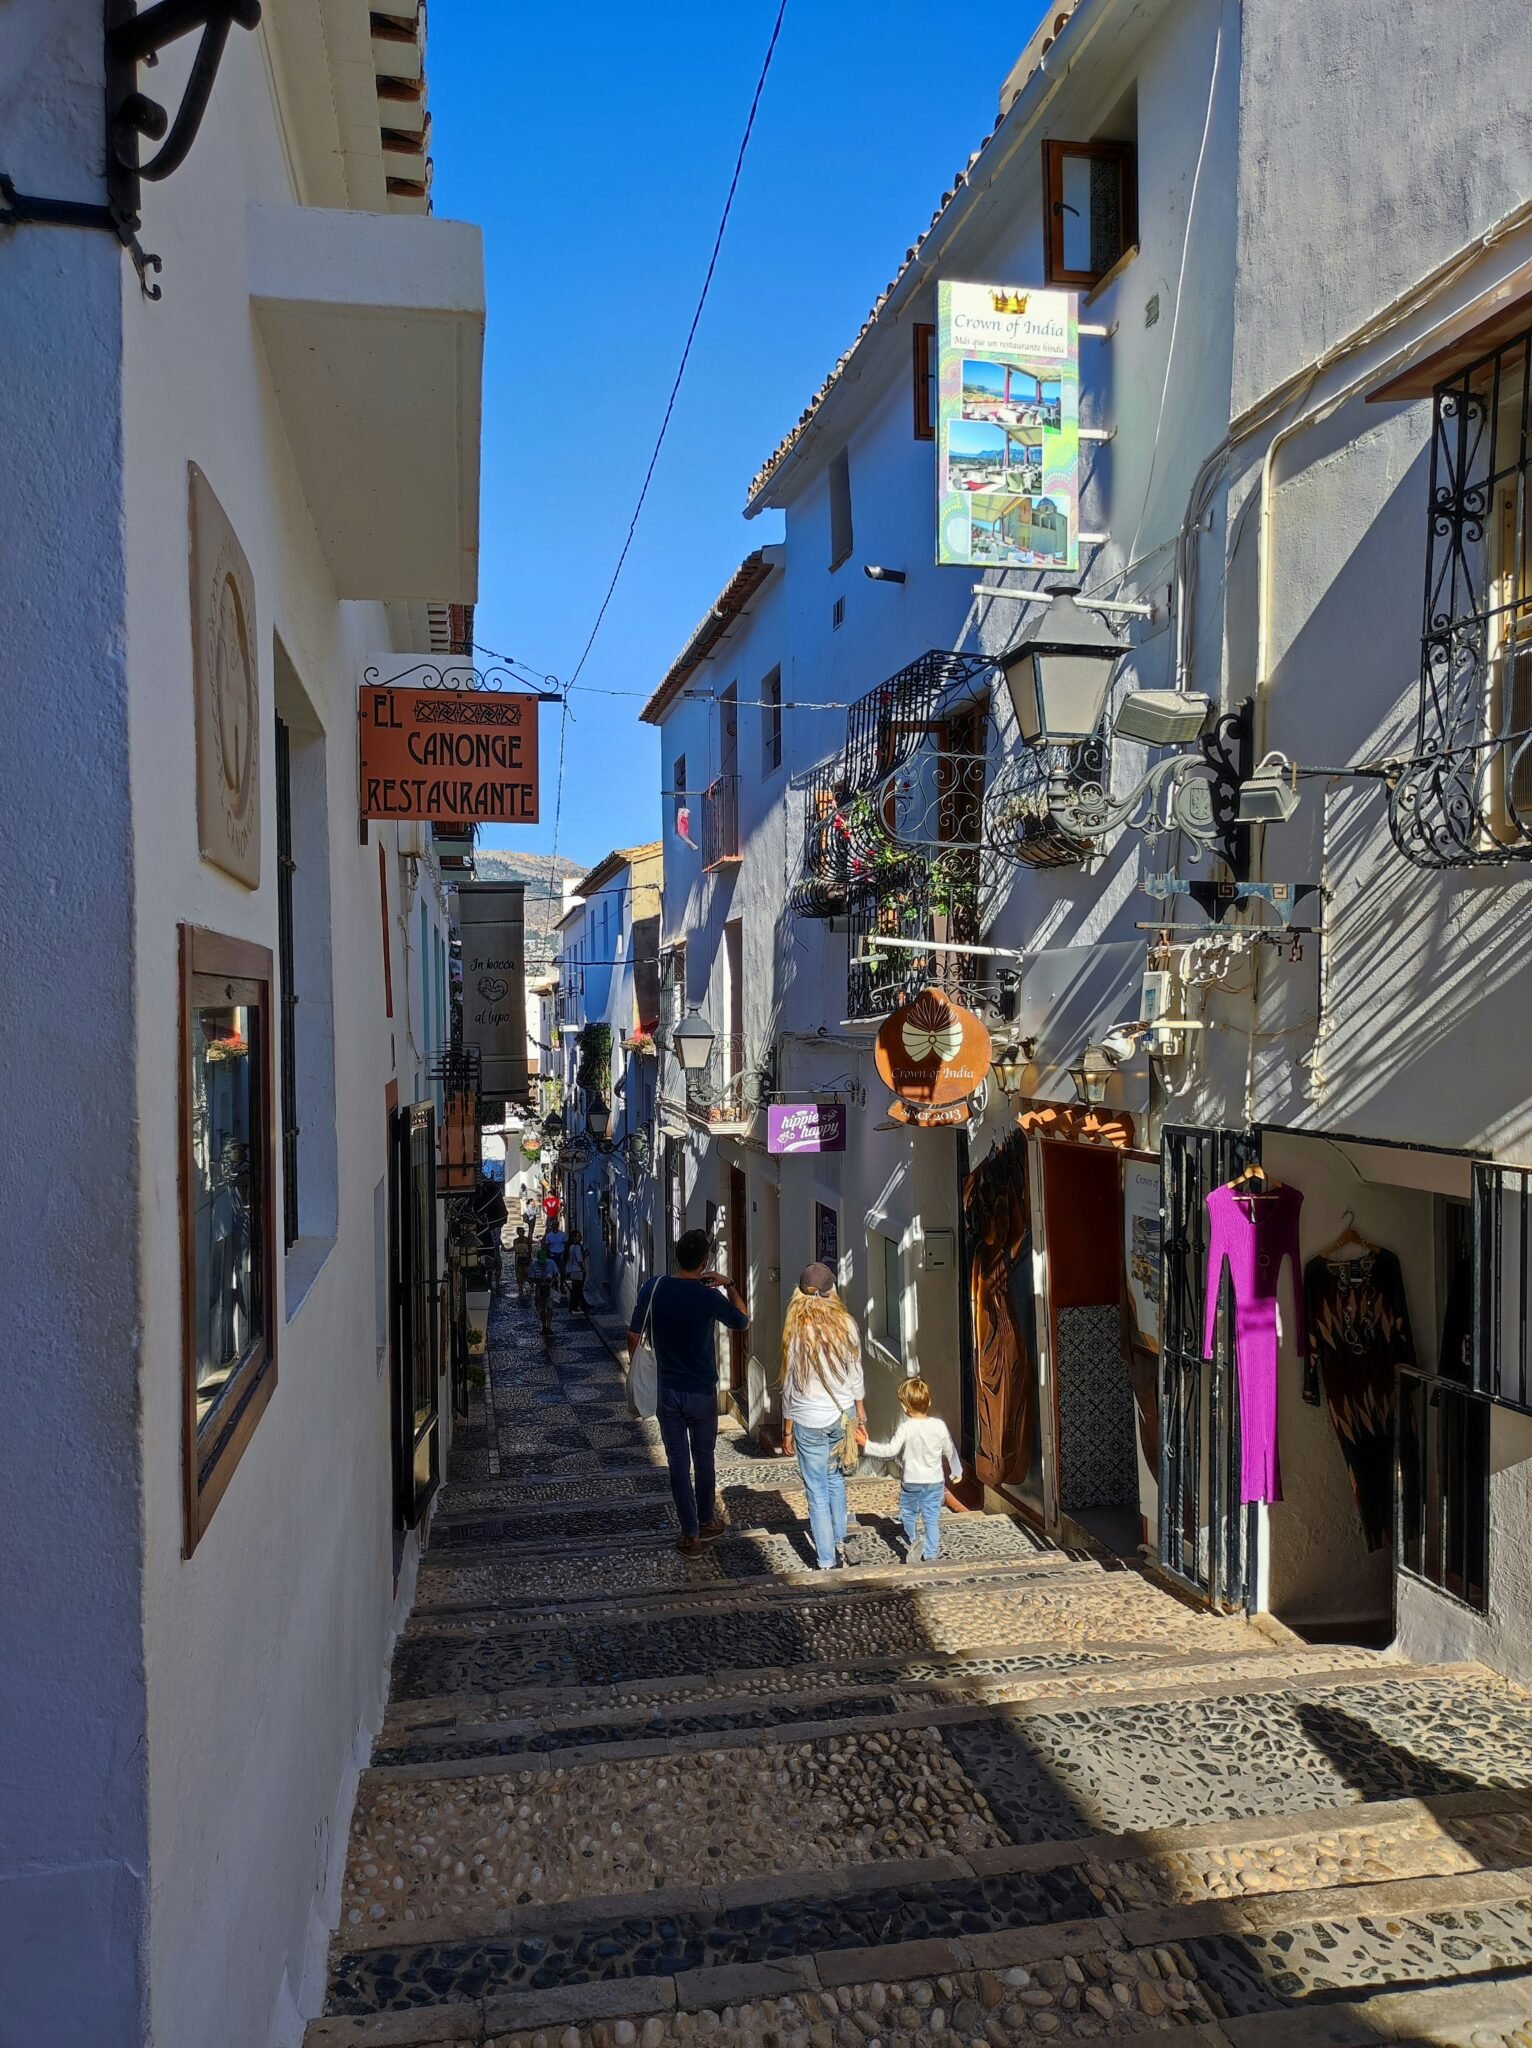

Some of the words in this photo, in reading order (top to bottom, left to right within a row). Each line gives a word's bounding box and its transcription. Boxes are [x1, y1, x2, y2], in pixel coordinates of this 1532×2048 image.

[955, 314, 1000, 331] Crown
[1005, 316, 1023, 340] of
[1024, 319, 1064, 337] India
[972, 338, 985, 349] que
[1000, 342, 1040, 351] restaurante
[374, 694, 403, 728] EL
[407, 731, 523, 769] CANONGE
[367, 778, 535, 817] RESTAURANTE
[487, 957, 515, 970] bocca
[475, 1010, 485, 1024] al
[489, 1010, 510, 1026] lupo
[891, 1067, 926, 1080] Crown
[929, 1067, 942, 1083] of
[942, 1064, 974, 1080] India
[780, 1111, 820, 1131] hippie
[901, 1107, 932, 1121] SINCE
[933, 1108, 962, 1122] 2013
[800, 1121, 840, 1140] happy
